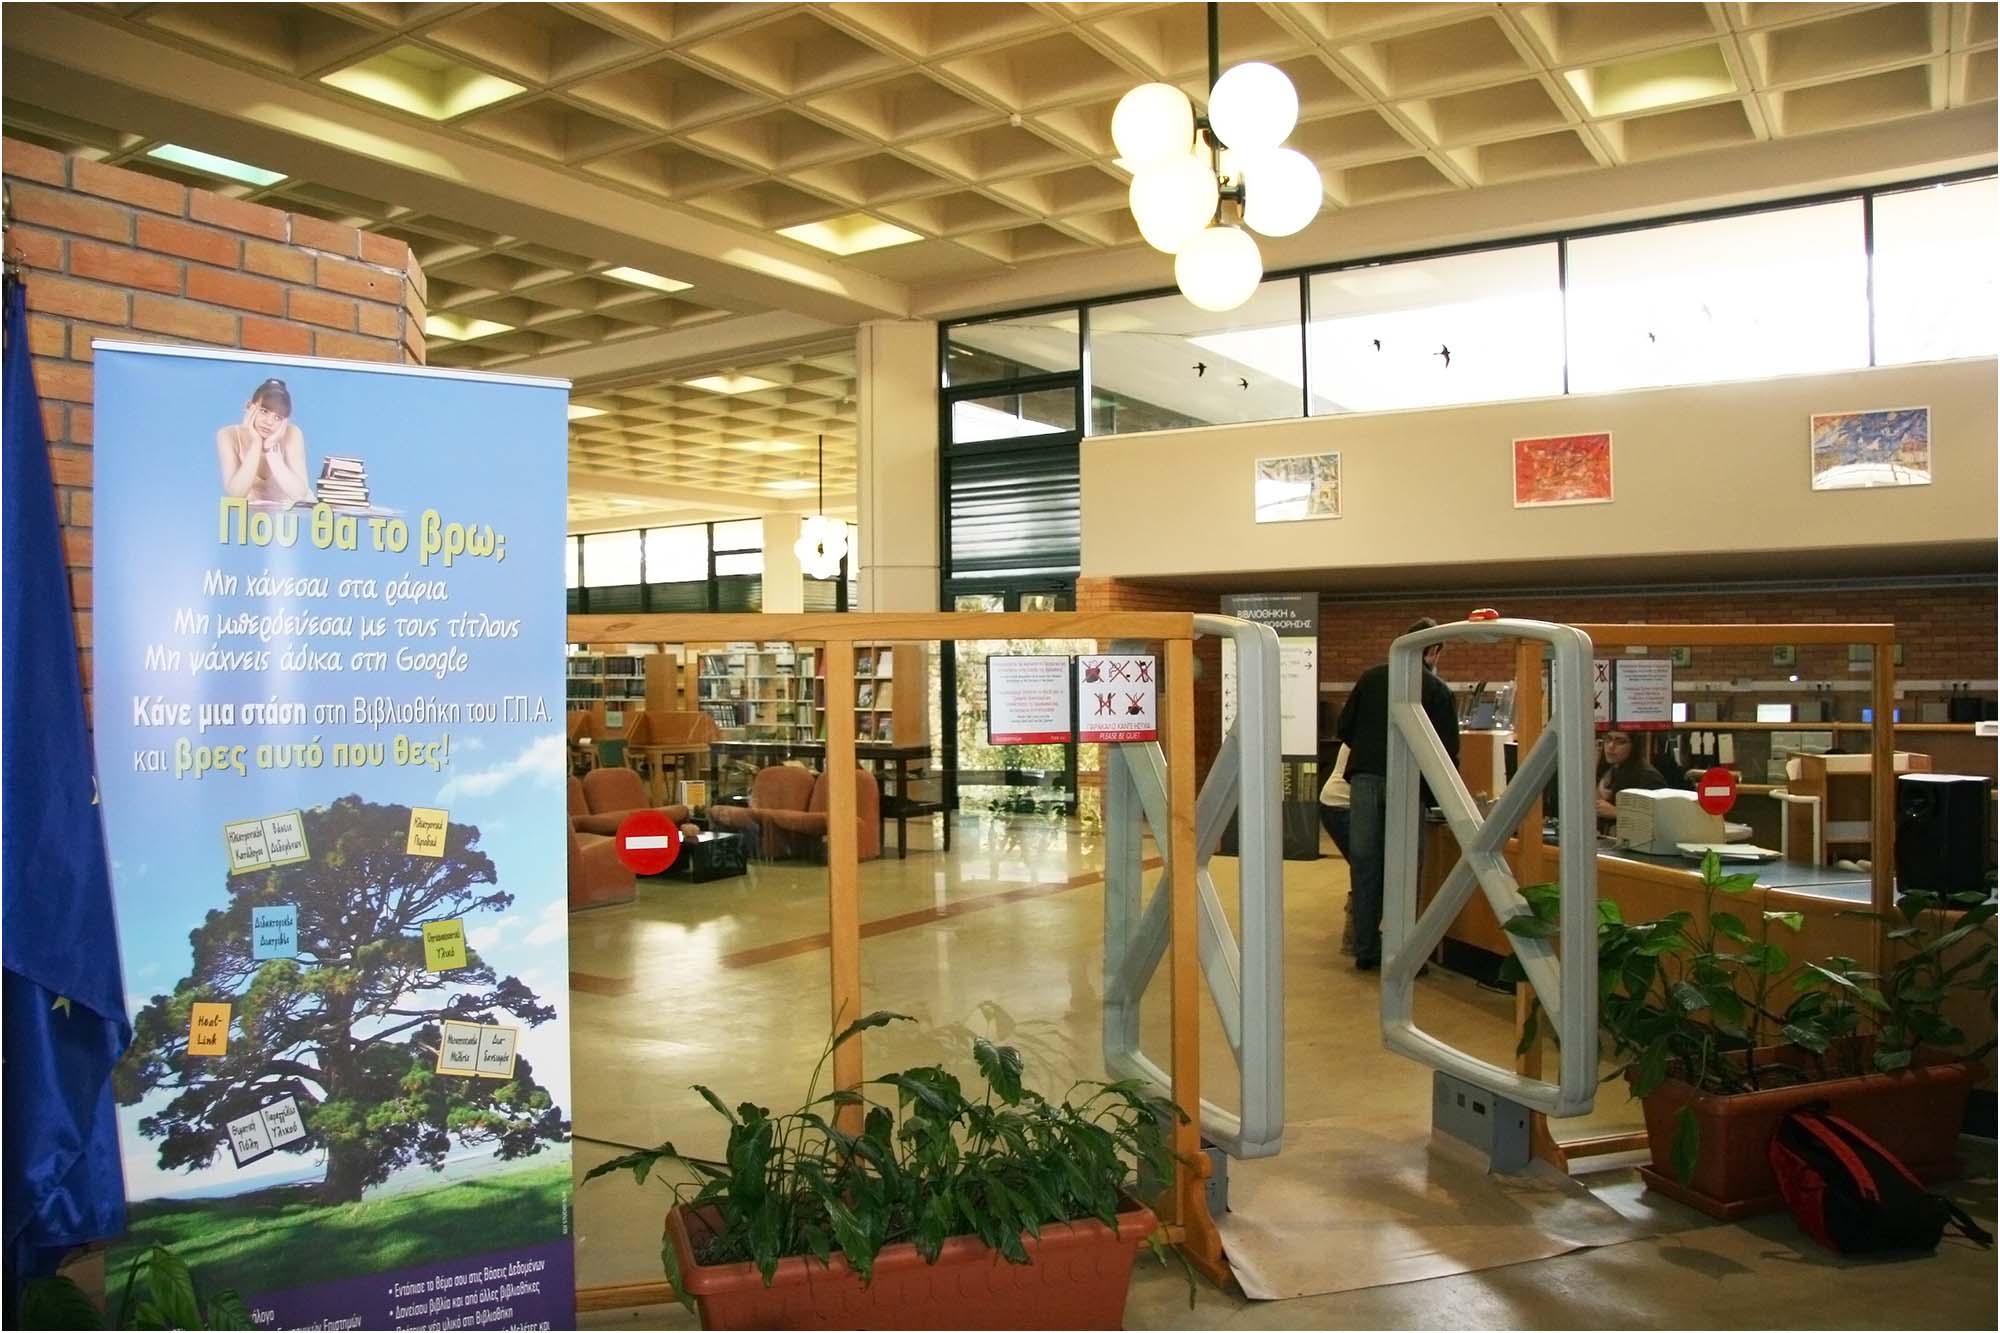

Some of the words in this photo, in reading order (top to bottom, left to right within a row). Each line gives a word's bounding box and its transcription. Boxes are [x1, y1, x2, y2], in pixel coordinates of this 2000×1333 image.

[218, 496, 299, 547] Πού
[311, 501, 358, 550] θα
[368, 517, 409, 552] το
[419, 508, 506, 567] βρω;
[202, 569, 239, 597] Μη
[246, 570, 329, 598] χάνεσαι
[338, 577, 378, 599] στα
[385, 572, 449, 606] ράφια
[175, 608, 209, 635] Μη
[217, 610, 353, 642] μπερδεύεσαι
[361, 614, 387, 640] με
[396, 616, 439, 637] τους
[447, 611, 521, 638] τίτλους
[145, 644, 181, 671] Μη
[189, 642, 271, 674] ψάχνεις
[280, 643, 344, 672] άδικα
[351, 648, 388, 671] στη
[396, 645, 469, 679] Google
[133, 695, 192, 727] Κάνε
[200, 703, 236, 732] μια
[241, 695, 307, 727] στάση
[315, 704, 348, 725] στη
[353, 697, 461, 731] Βιβλιοθήκη
[466, 702, 497, 723] του
[503, 696, 553, 723] Γ.Π.Α.
[134, 750, 168, 772] και
[176, 737, 247, 780] βρες
[256, 736, 324, 768] αυτό
[333, 745, 385, 768] που
[392, 733, 450, 771] θες!
[454, 1275, 468, 1287] σου
[508, 1258, 545, 1277] Δεδομένων
[464, 1290, 479, 1306] από
